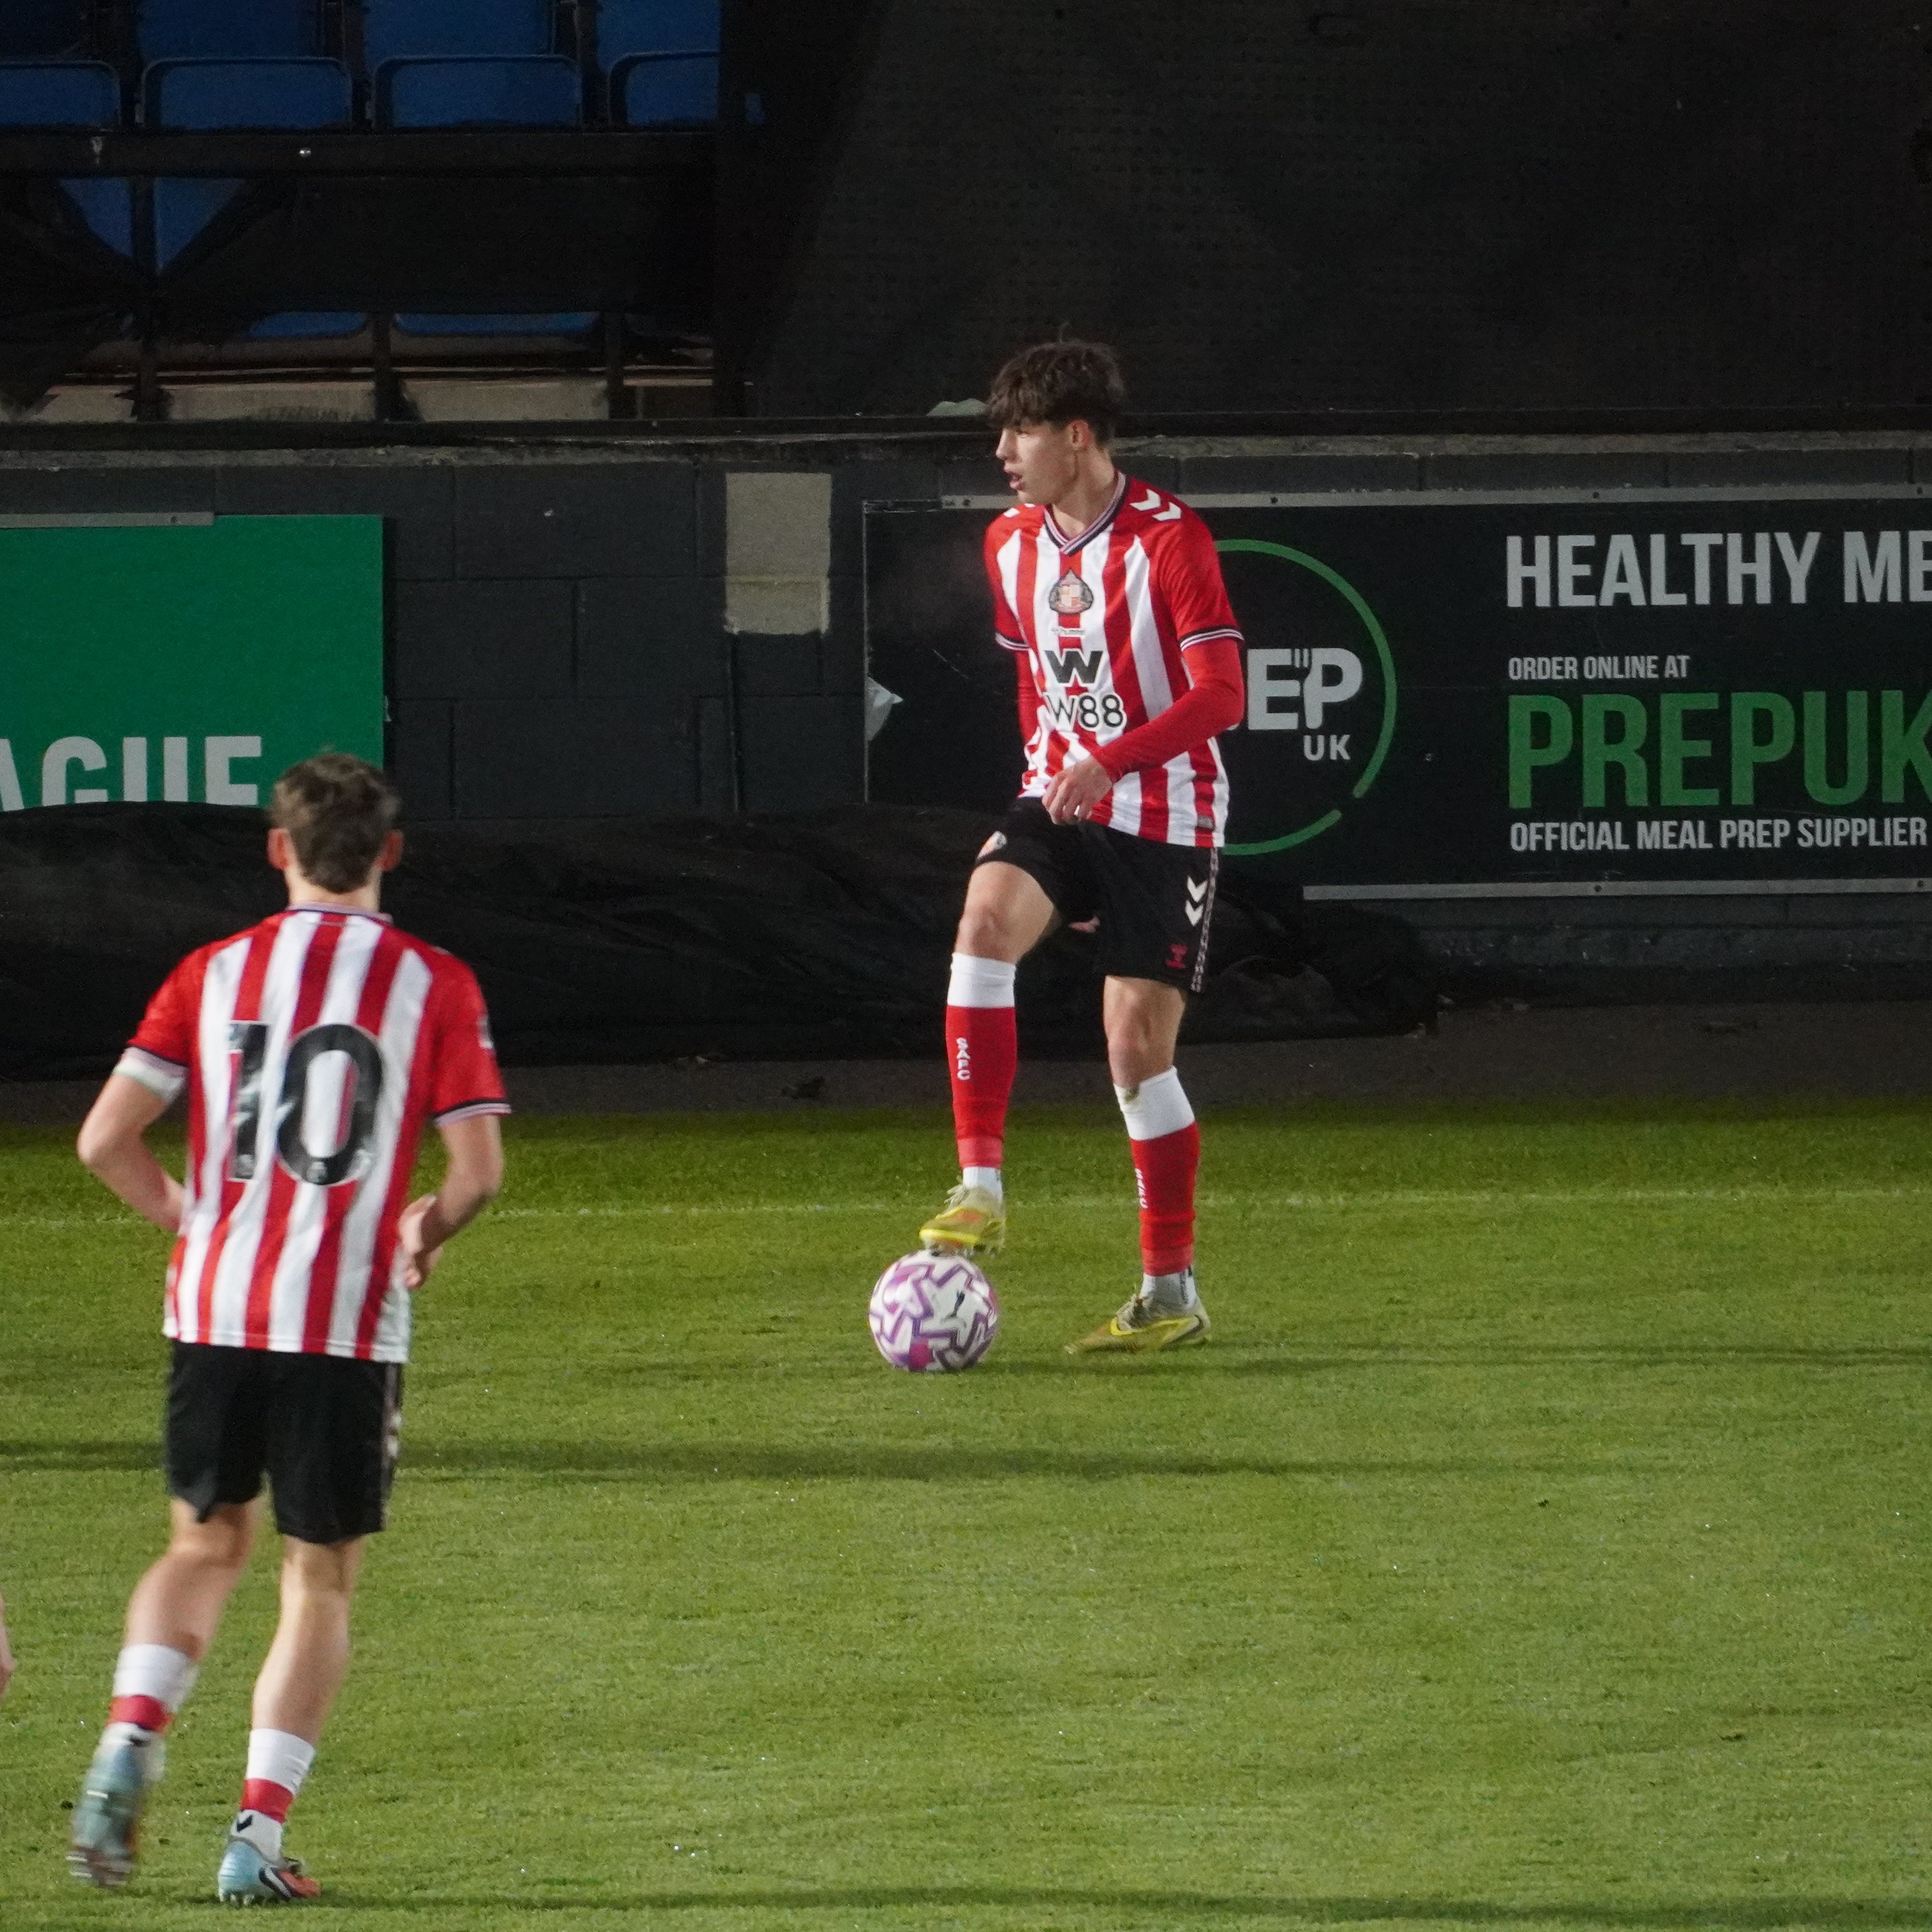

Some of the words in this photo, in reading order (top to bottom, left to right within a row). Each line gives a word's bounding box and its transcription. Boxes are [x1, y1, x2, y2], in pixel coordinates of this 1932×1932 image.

[1506, 531, 1822, 608] HEALTHY
[1044, 650, 1103, 684] W
[1509, 656, 1578, 680] ORDER
[1583, 655, 1659, 680] ONLINE
[1664, 654, 1690, 679] AT
[1226, 647, 1363, 731] EP
[1046, 694, 1123, 728] W88
[1303, 734, 1351, 761] UK
[1508, 690, 1932, 809] PREPUK
[1510, 821, 1629, 852] OFFICIAL
[1637, 819, 1713, 850] MEAL
[1720, 818, 1791, 849] PREP
[1796, 817, 1928, 848] SUPPLIER
[228, 1022, 383, 1186] 10
